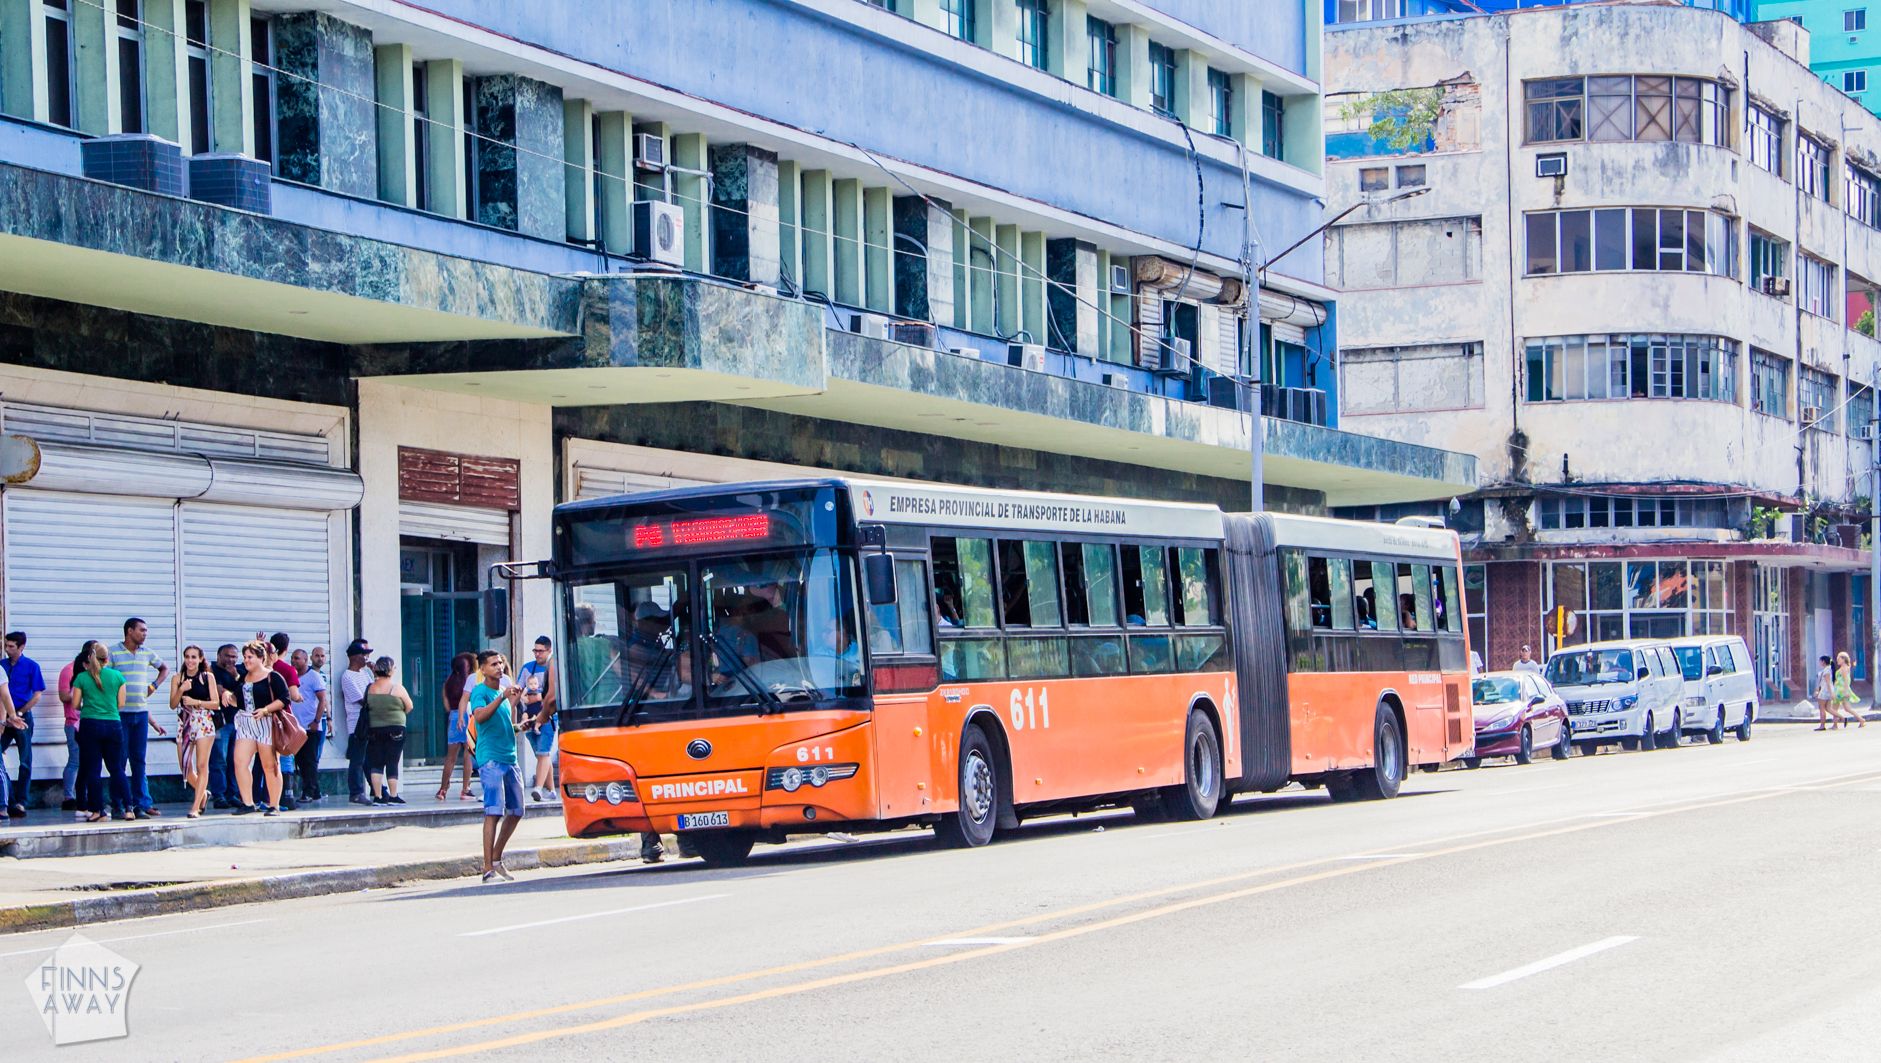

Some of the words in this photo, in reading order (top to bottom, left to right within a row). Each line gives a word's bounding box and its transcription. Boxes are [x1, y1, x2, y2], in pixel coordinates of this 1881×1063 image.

[890, 496, 937, 515] EMPRESA
[939, 499, 996, 518] PROVINCIAL
[998, 503, 1009, 518] DE
[1011, 503, 1068, 522] TRANSPORTE
[1069, 507, 1080, 523] DE
[1082, 508, 1092, 523] LA
[1094, 509, 1127, 525] HABANA
[1009, 686, 1049, 731] 611
[796, 746, 834, 762] 611
[651, 778, 748, 799] PRINCIPAL
